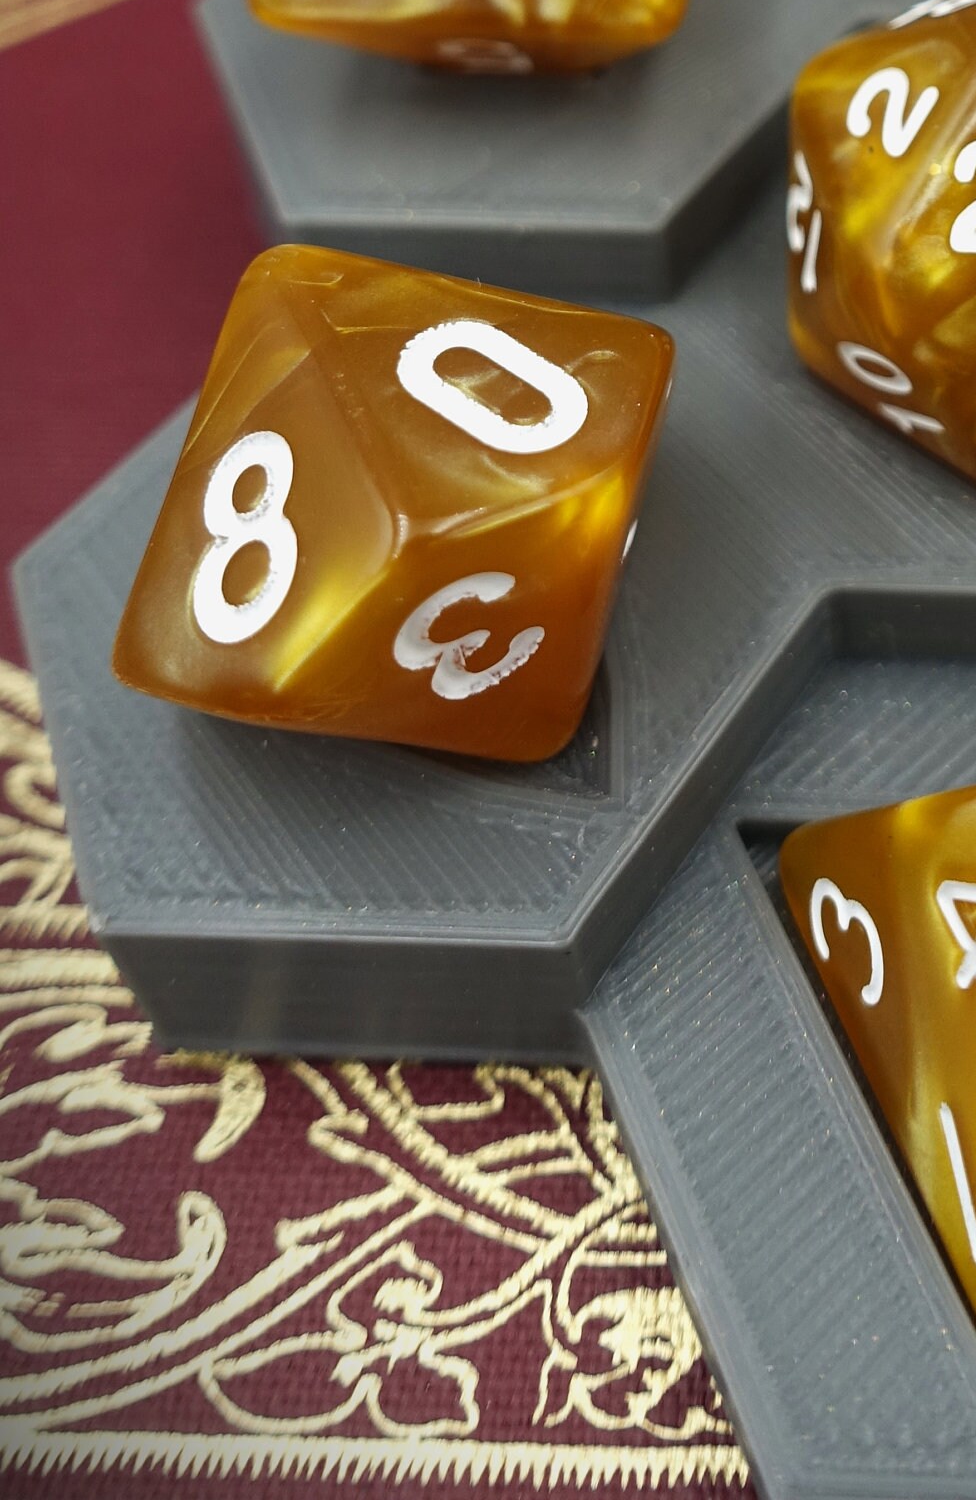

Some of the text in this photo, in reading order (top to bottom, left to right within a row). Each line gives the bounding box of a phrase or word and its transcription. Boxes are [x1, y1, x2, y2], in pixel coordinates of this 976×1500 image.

[847, 68, 938, 157] 2
[397, 318, 588, 453] 0
[193, 431, 298, 644] 8
[394, 573, 544, 700] 3
[811, 879, 883, 1005] 3
